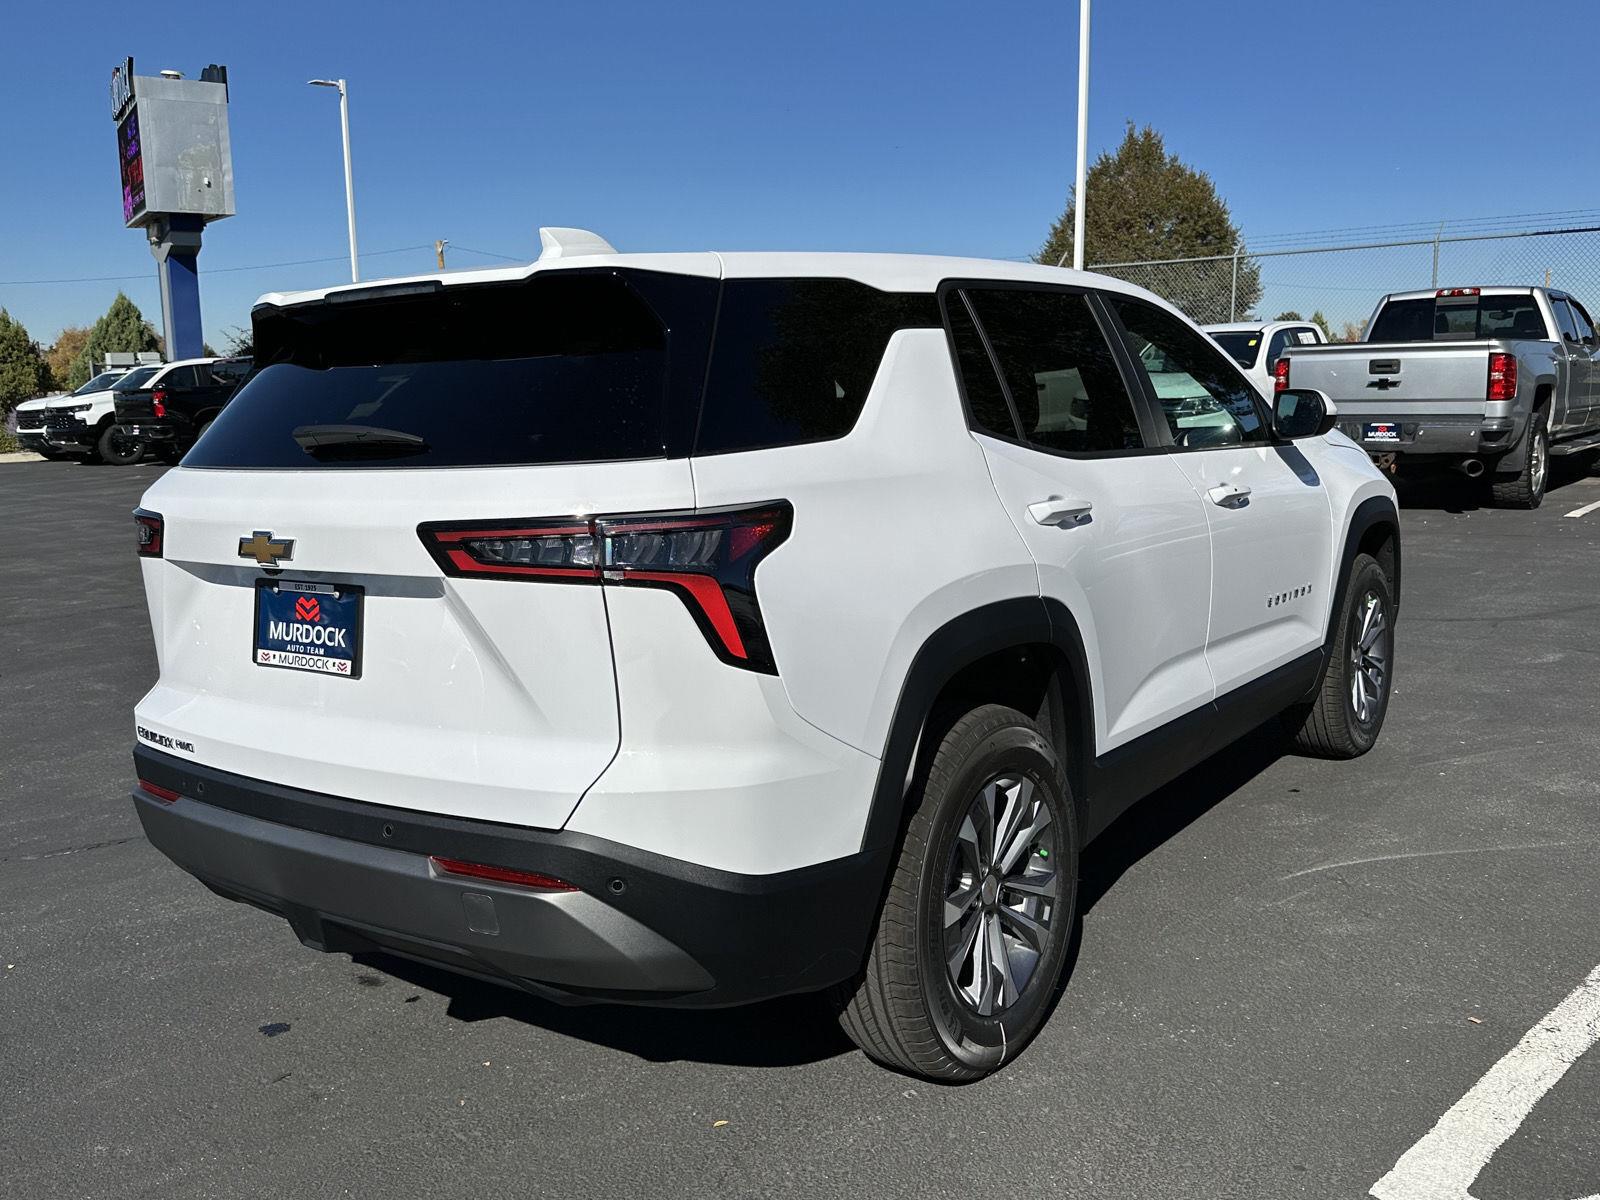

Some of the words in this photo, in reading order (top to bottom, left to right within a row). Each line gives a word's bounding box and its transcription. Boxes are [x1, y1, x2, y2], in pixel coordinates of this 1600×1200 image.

[269, 620, 346, 648] MURDOCK
[286, 644, 305, 653] AUTO
[306, 646, 325, 655] TEAM
[278, 653, 330, 670] MURDOCK
